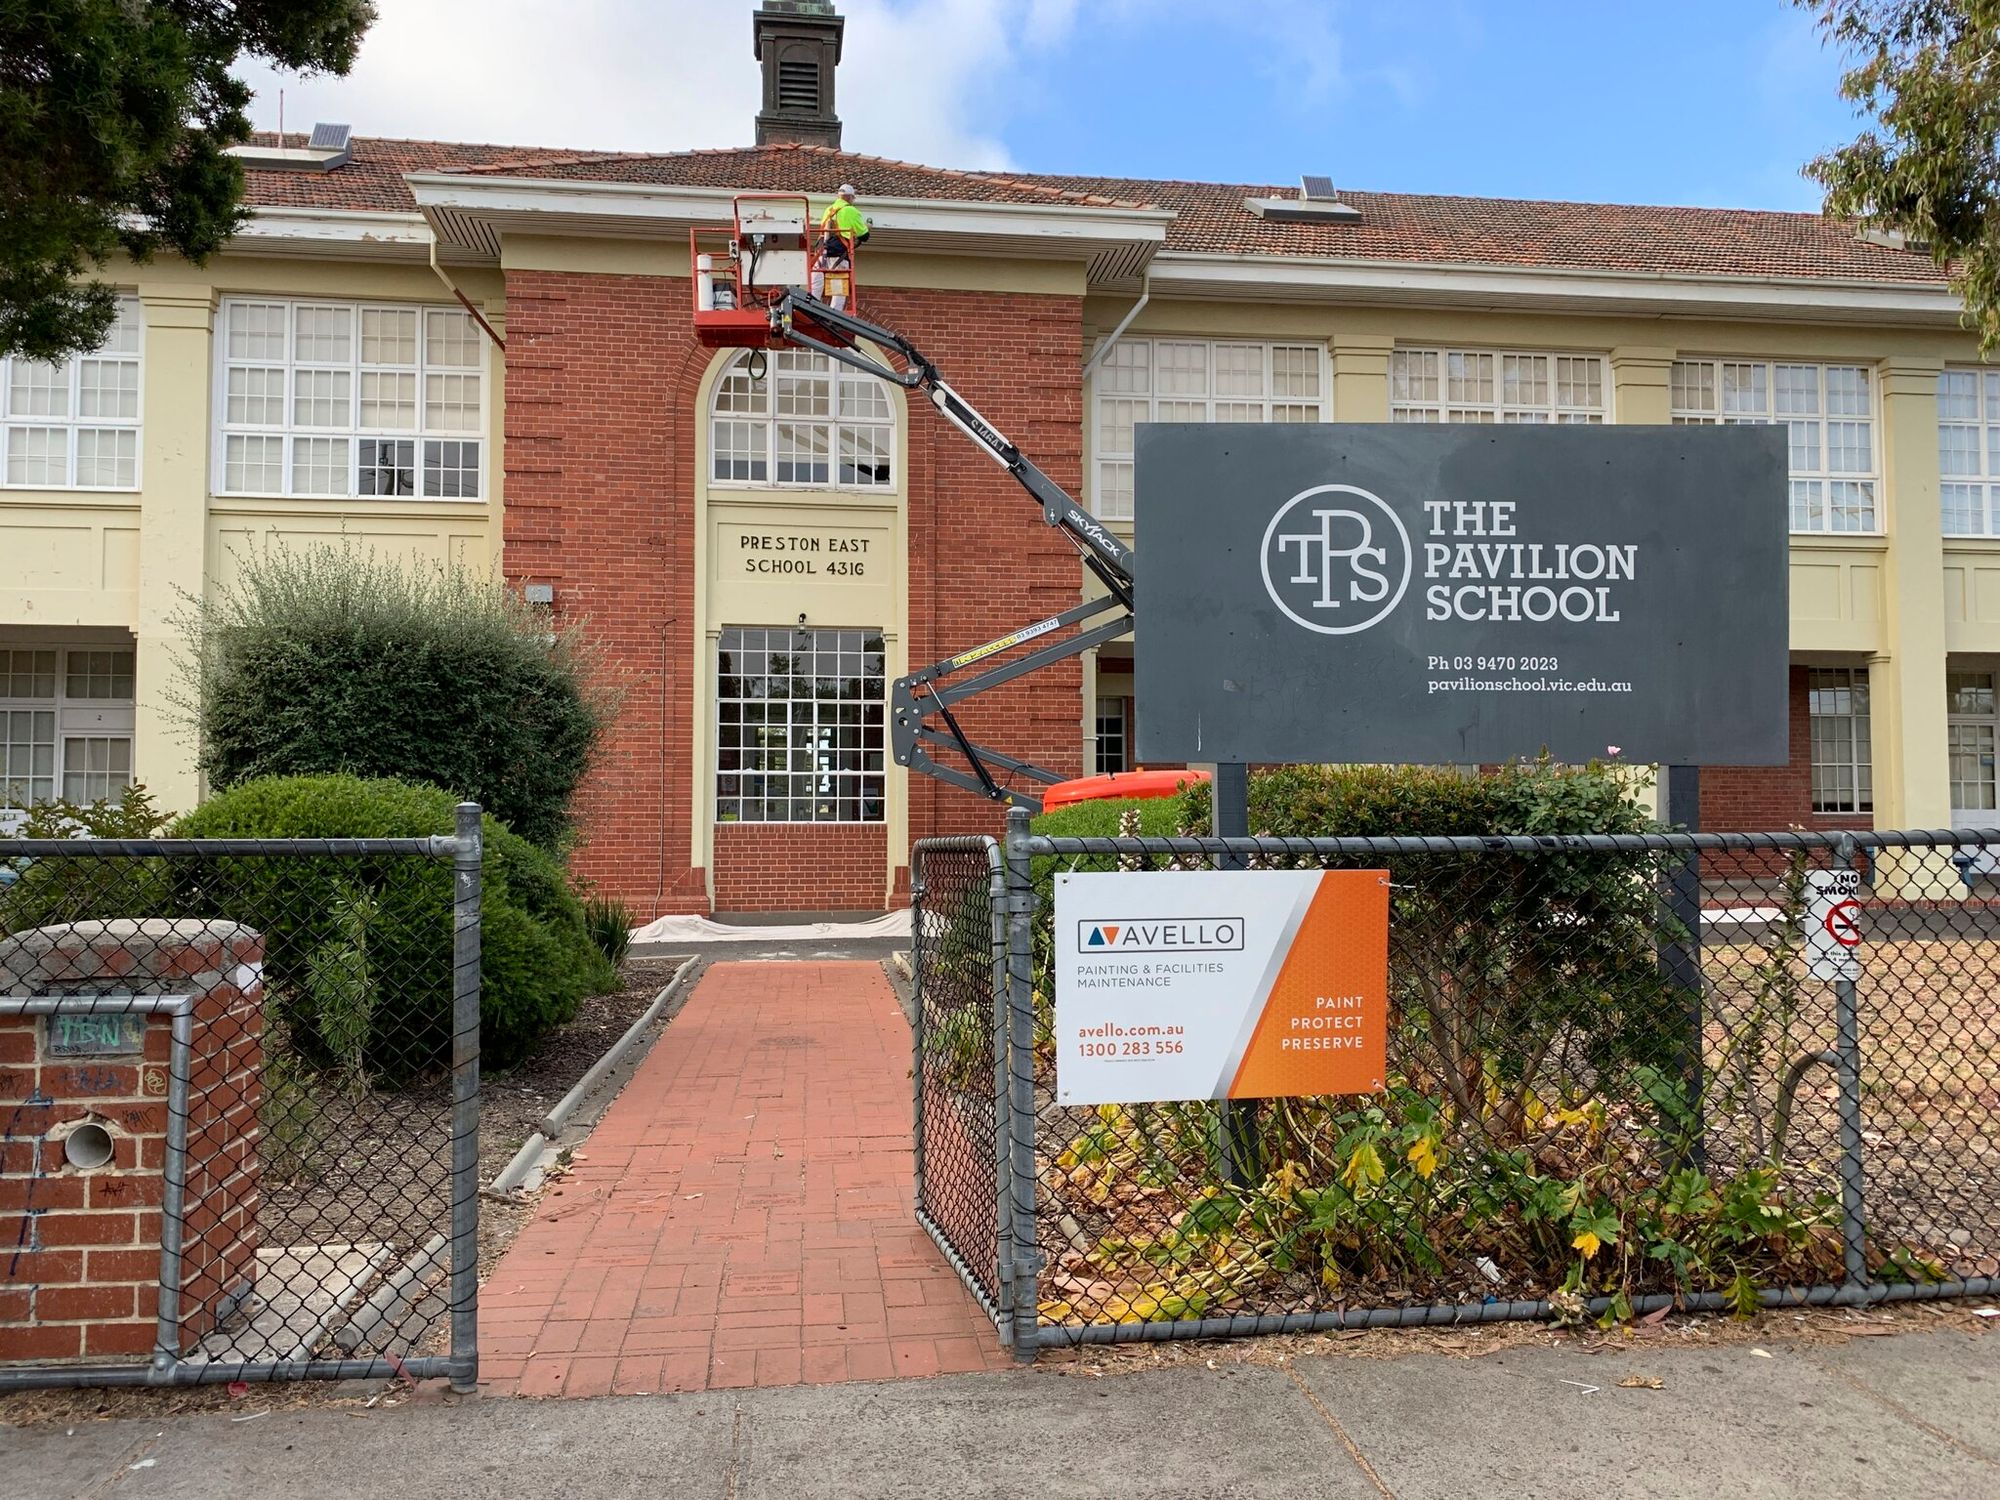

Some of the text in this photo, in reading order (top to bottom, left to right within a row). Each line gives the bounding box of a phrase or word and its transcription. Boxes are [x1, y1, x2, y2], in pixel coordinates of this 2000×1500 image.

[1423, 500, 1516, 537] THE
[1067, 509, 1121, 557] SKYJACK
[740, 535, 870, 552] PRESTON EAST
[745, 558, 817, 574] SCHOOL
[1423, 543, 1638, 581] PAVILION
[1426, 585, 1620, 622] SCHOOL
[1428, 656, 1559, 671] Ph 03 9470 2023
[1427, 677, 1633, 694] pavilionschool.vic.edu.au
[1840, 874, 1858, 884] NO
[1122, 924, 1235, 946] AVELLO
[1077, 963, 1224, 976] PAINTING & FACILITIES
[1077, 977, 1171, 988] MAINTENANCE
[1316, 996, 1363, 1009] PAINT
[1079, 1023, 1184, 1038] avello.com.au
[1291, 1016, 1363, 1029] PROTECT
[1079, 1040, 1184, 1057] 1300 283 556
[1282, 1036, 1363, 1050] PRESERVE
